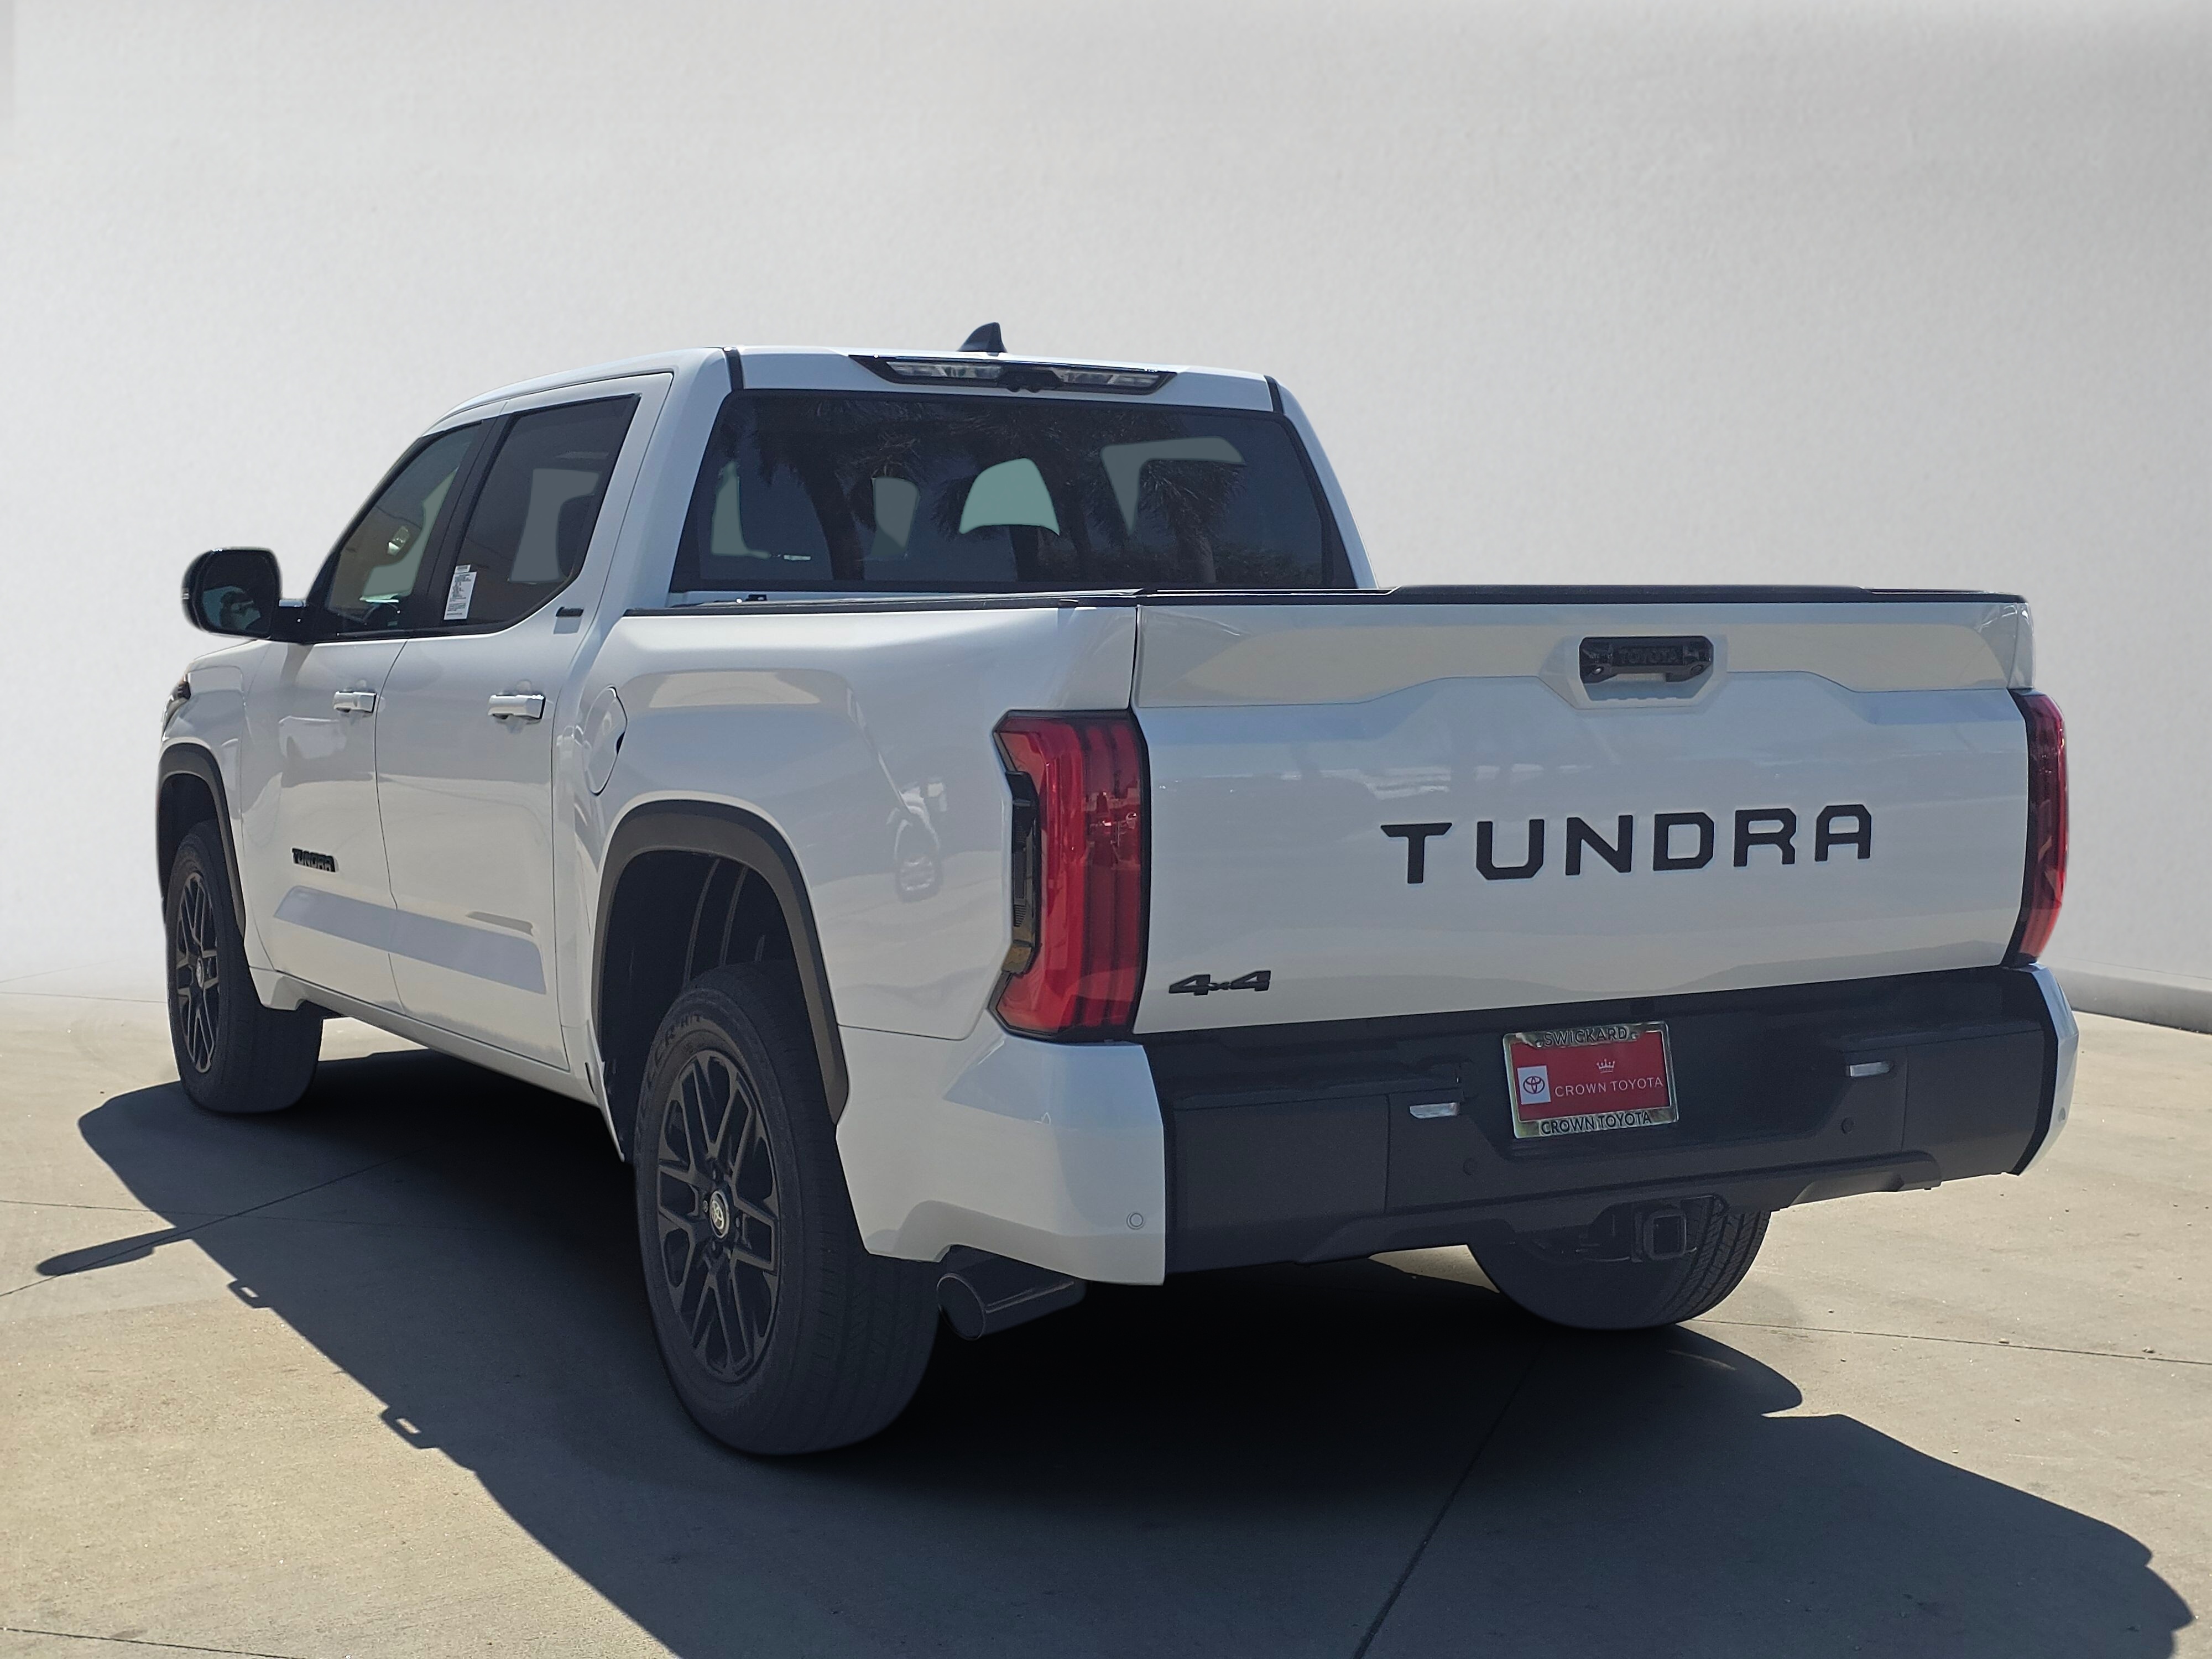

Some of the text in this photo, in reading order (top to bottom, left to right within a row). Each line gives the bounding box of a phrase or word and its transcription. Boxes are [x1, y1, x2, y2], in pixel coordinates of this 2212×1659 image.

[1380, 804, 1872, 884] TUNDRA
[291, 847, 336, 873] TUNDRA
[1168, 970, 1271, 997] 4x4
[1543, 1027, 1629, 1046] SWICKARD
[1554, 1077, 1664, 1098] CROWN TOYOTA
[1540, 1111, 1652, 1135] CROWN TOYOTA
